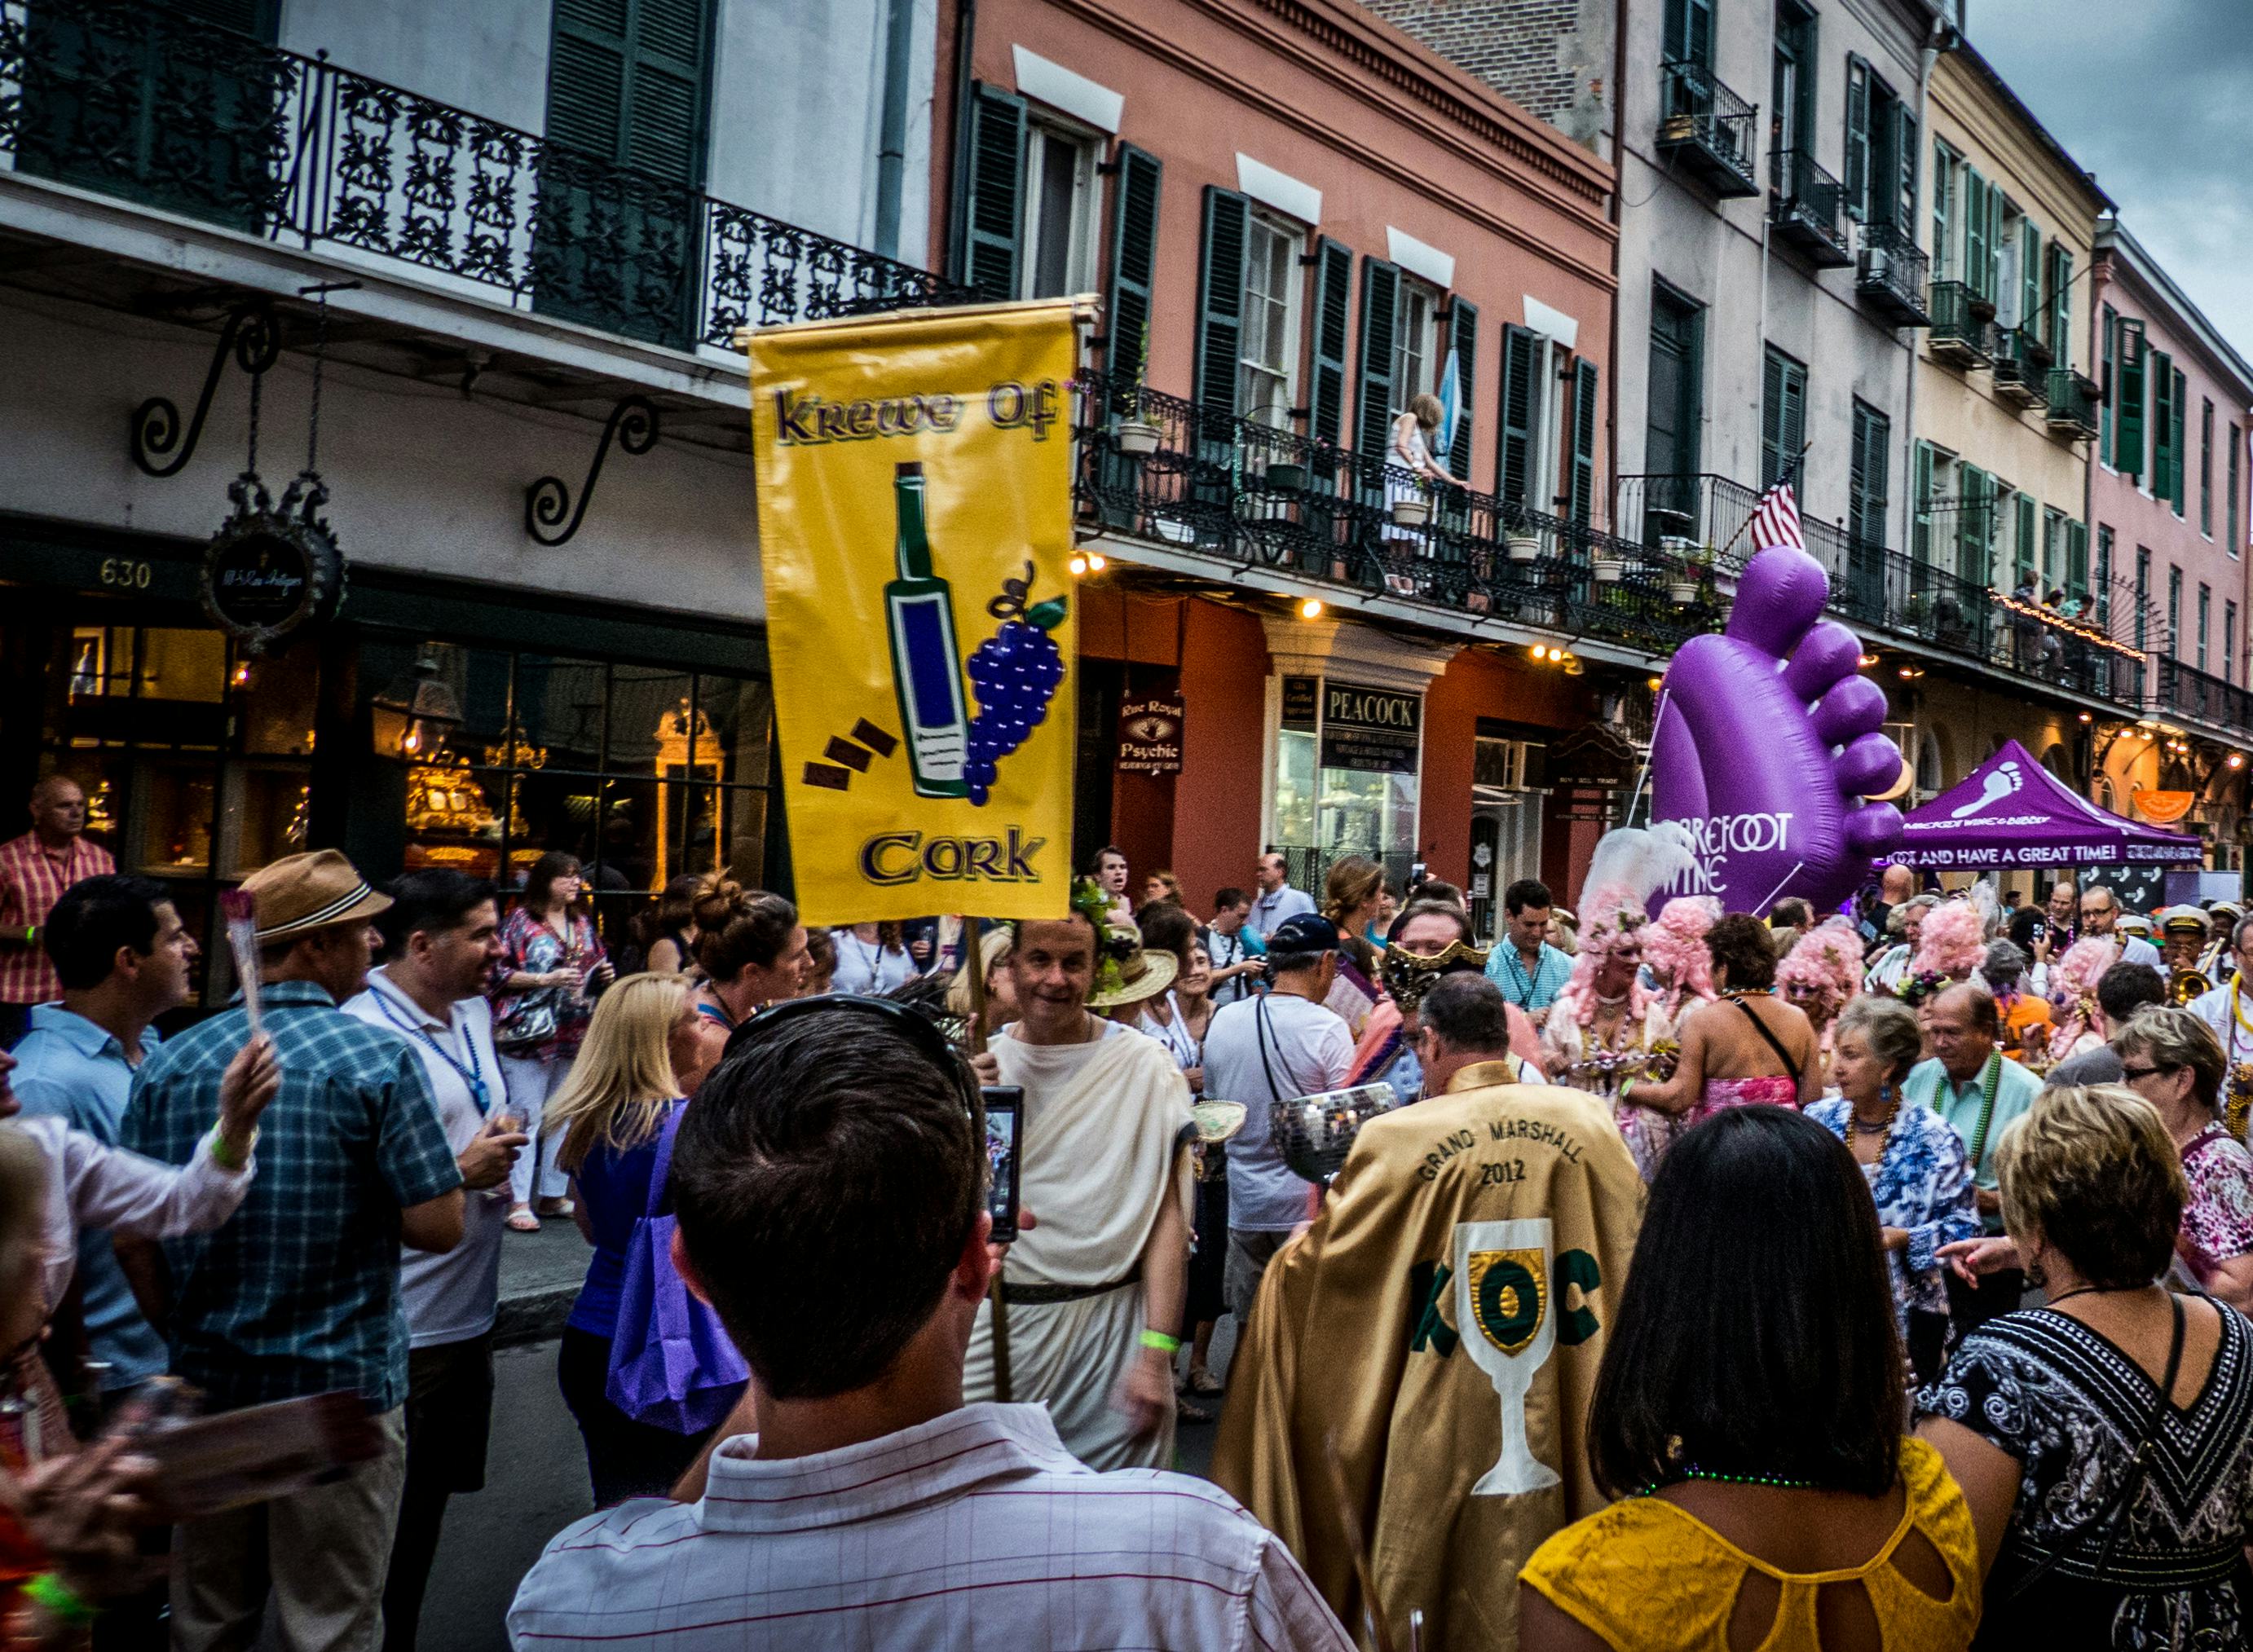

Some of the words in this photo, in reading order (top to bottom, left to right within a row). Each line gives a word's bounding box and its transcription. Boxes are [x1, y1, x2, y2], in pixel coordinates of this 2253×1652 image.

[774, 386, 964, 446] Krewe
[988, 378, 1057, 441] Of
[101, 557, 151, 588] 630
[1122, 704, 1145, 717] Rue
[1149, 701, 1183, 717] Royal
[1329, 691, 1413, 726] PEACOCK
[1121, 742, 1179, 760] Psychic
[1680, 813, 1793, 855] REFOOT
[859, 824, 1047, 886] Cork
[1919, 849, 1954, 865] AND
[1957, 848, 1999, 864] HAVE
[2002, 848, 2016, 862] A
[2017, 846, 2070, 862] GREAT
[2073, 844, 2117, 861] TIME!
[1418, 1129, 1475, 1181] GRAND
[1489, 1119, 1583, 1164] MARSHALL
[1480, 1158, 1526, 1184] 2012
